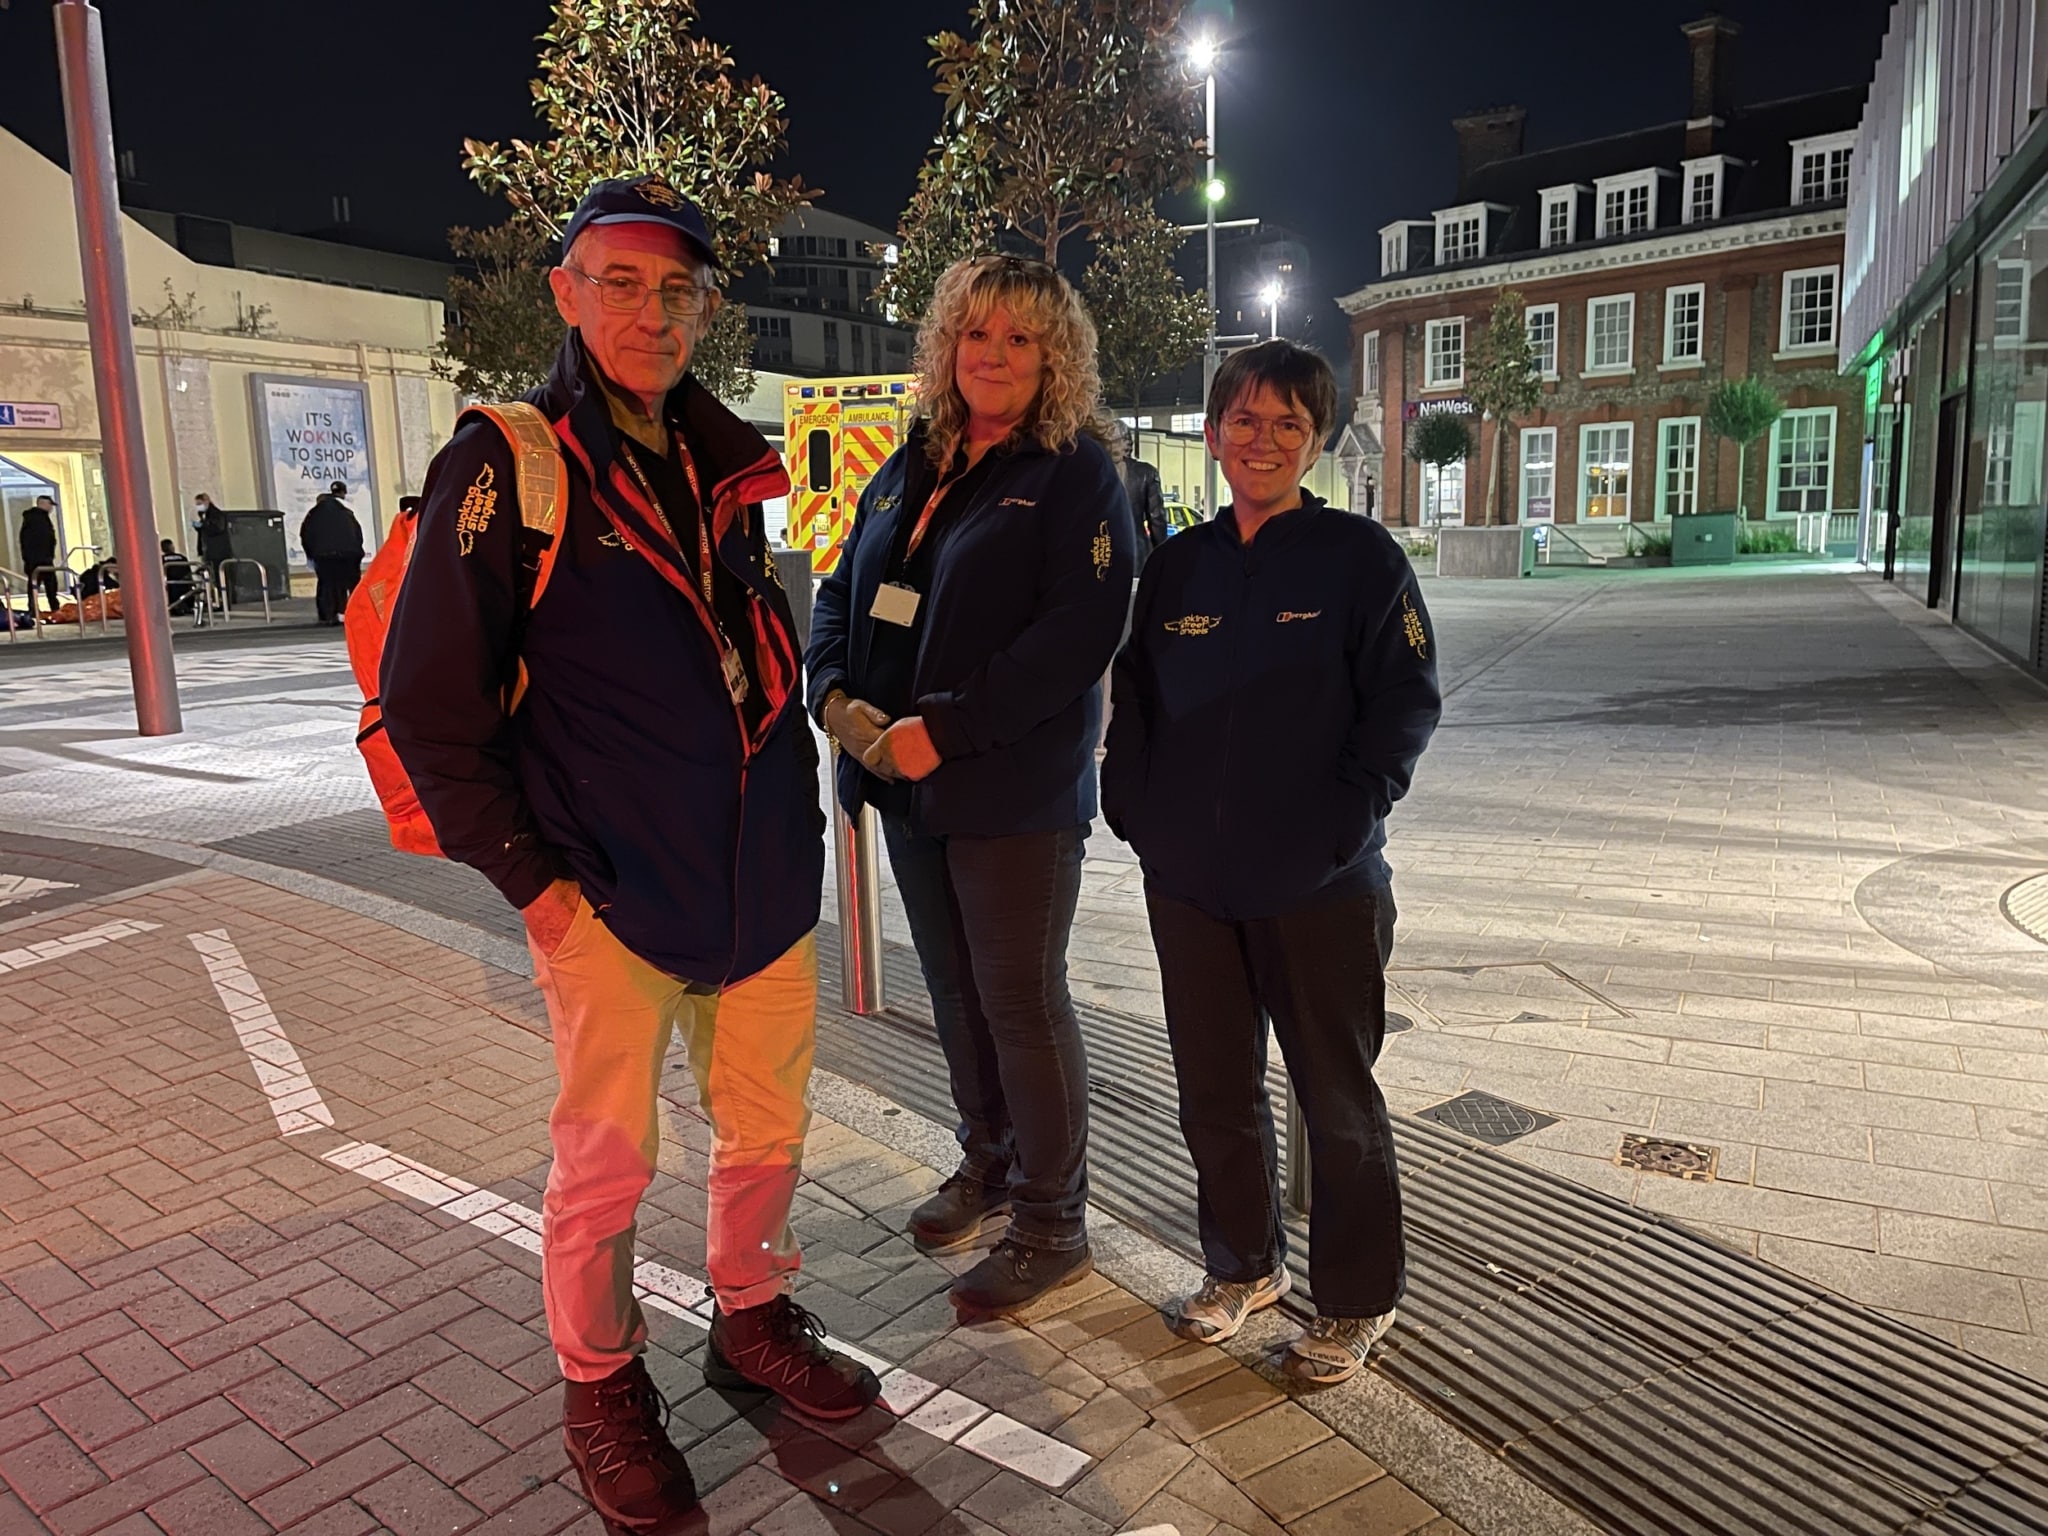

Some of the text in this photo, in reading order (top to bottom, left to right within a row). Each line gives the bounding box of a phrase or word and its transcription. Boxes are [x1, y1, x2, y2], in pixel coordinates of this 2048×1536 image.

[1420, 400, 1473, 417] NatWest
[305, 412, 332, 427] IT'S
[800, 412, 889, 424] EMERGENCY AMBULANCE
[289, 447, 354, 463] TO SHOP
[301, 466, 348, 480] AGAIN
[456, 485, 482, 532] woking
[467, 493, 490, 531] street
[478, 489, 498, 533] angels
[653, 502, 673, 535] VISITOR
